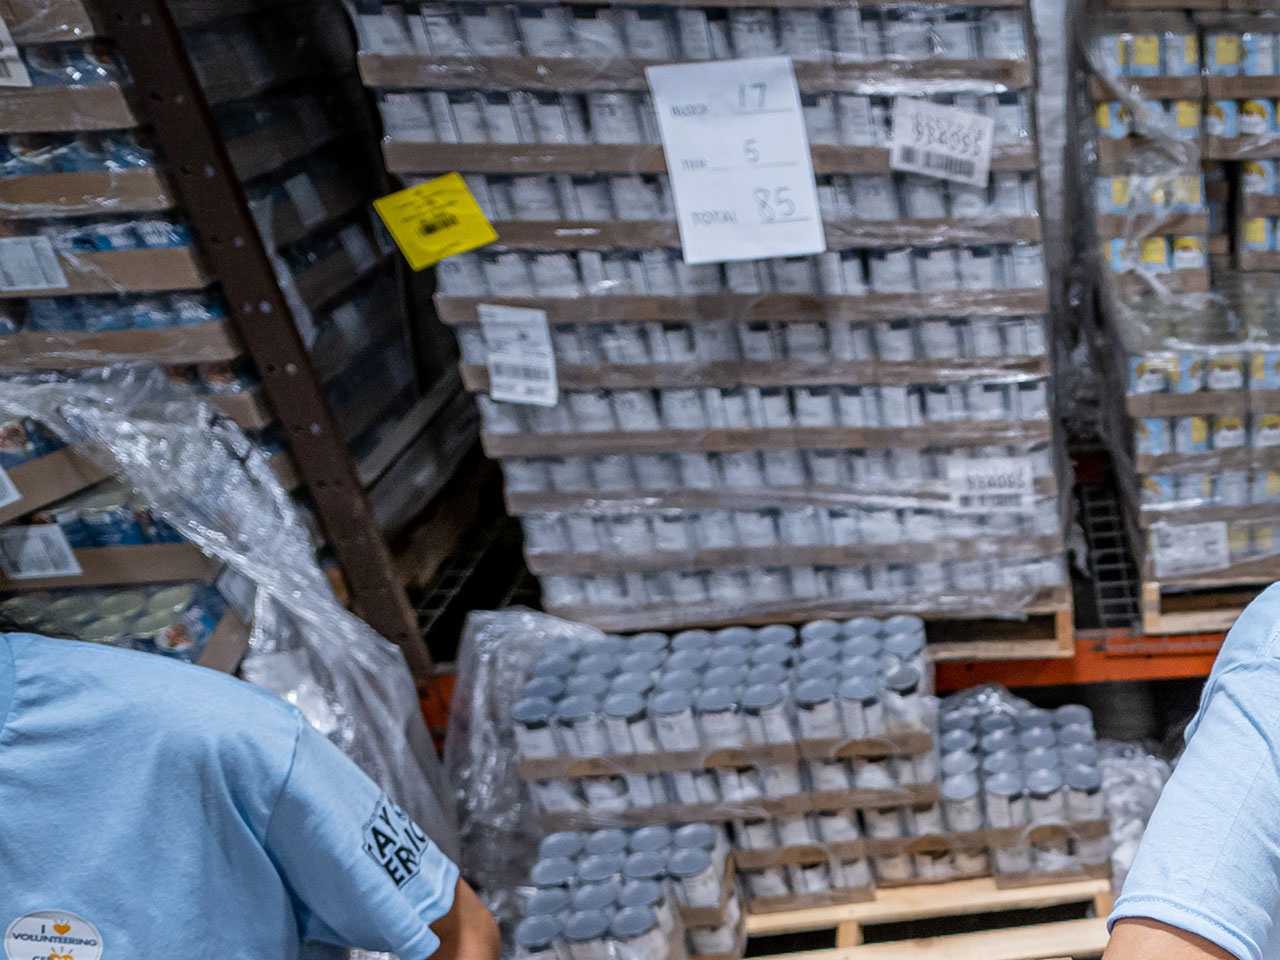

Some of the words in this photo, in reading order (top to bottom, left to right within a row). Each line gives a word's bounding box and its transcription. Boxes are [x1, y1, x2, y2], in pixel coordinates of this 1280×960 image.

[737, 82, 767, 109] 17
[743, 138, 760, 163] 5
[754, 186, 796, 223] 85
[367, 806, 399, 859] AY
[12, 932, 97, 946] VOLUNTEERING
[41, 924, 46, 934] I
